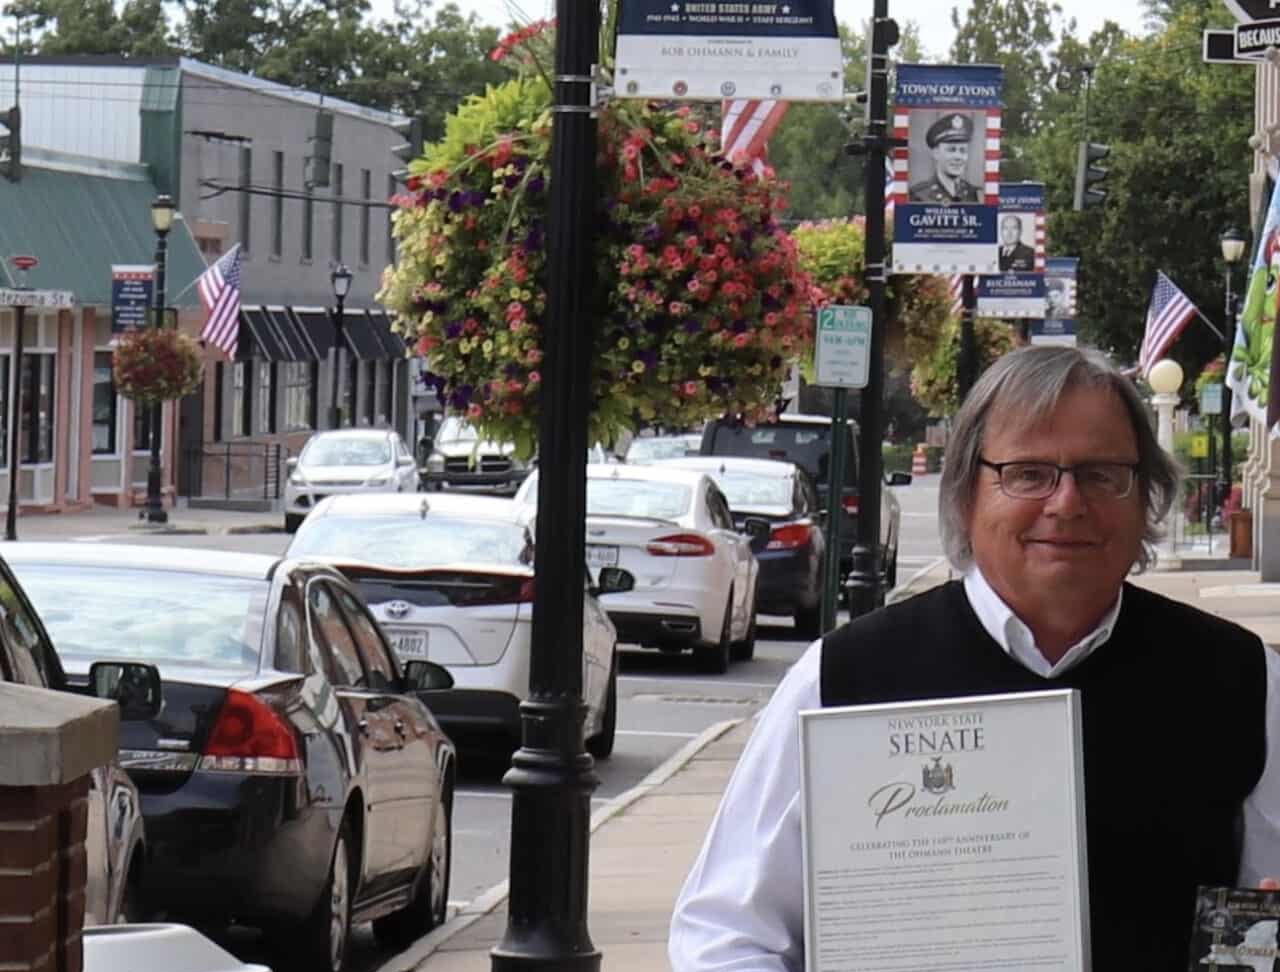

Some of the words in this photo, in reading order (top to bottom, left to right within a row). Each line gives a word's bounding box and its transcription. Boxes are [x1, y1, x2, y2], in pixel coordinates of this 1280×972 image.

[718, 4, 750, 13] STATES
[752, 4, 777, 14] ARMY
[661, 47, 684, 57] BOB
[687, 47, 743, 57] OHMANN
[758, 48, 799, 58] FAMILY
[901, 84, 938, 96] TOWN
[939, 84, 956, 95] OF
[957, 85, 997, 97] LYONS
[909, 214, 959, 227] GAVITT
[962, 215, 982, 227] SR.
[822, 310, 834, 329] 2
[887, 718, 914, 730] NEW
[916, 715, 950, 728] YORK
[953, 712, 984, 726] STATE
[889, 728, 985, 755] SENATE
[867, 782, 1010, 829] Proclamation
